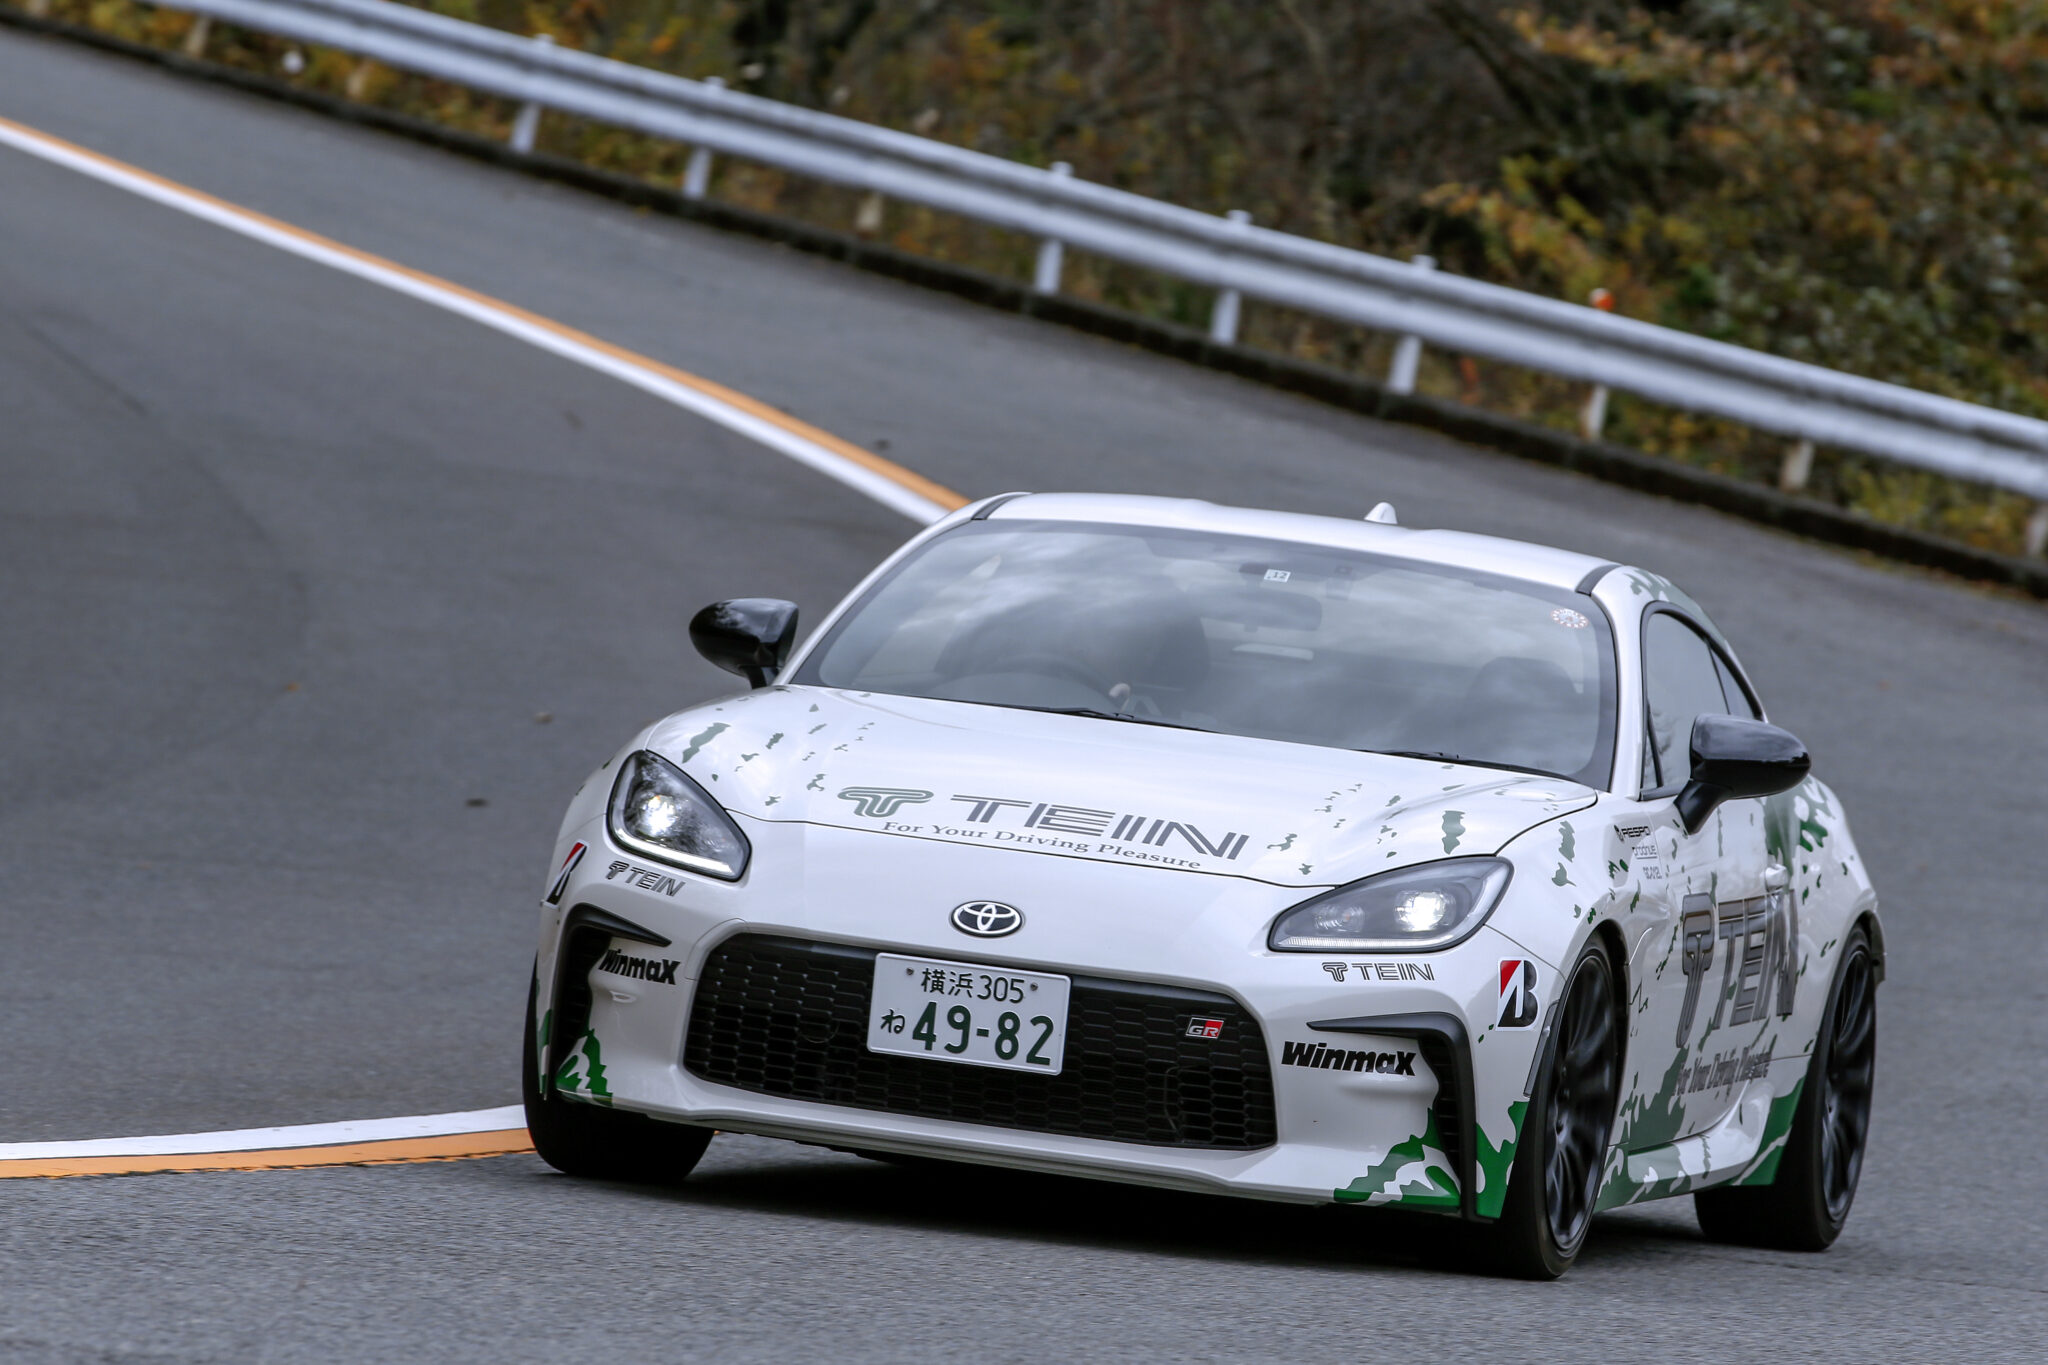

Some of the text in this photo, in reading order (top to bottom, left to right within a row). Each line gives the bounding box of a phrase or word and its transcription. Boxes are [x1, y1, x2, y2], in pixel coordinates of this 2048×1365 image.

[882, 822, 1202, 869] For Your Driving Pleasure
[951, 794, 1249, 860] TEIN
[625, 866, 686, 897] TEIN
[1351, 963, 1435, 981] TEIN
[880, 1001, 1054, 1066] ね 49-82
[1188, 1025, 1220, 1037] GR
